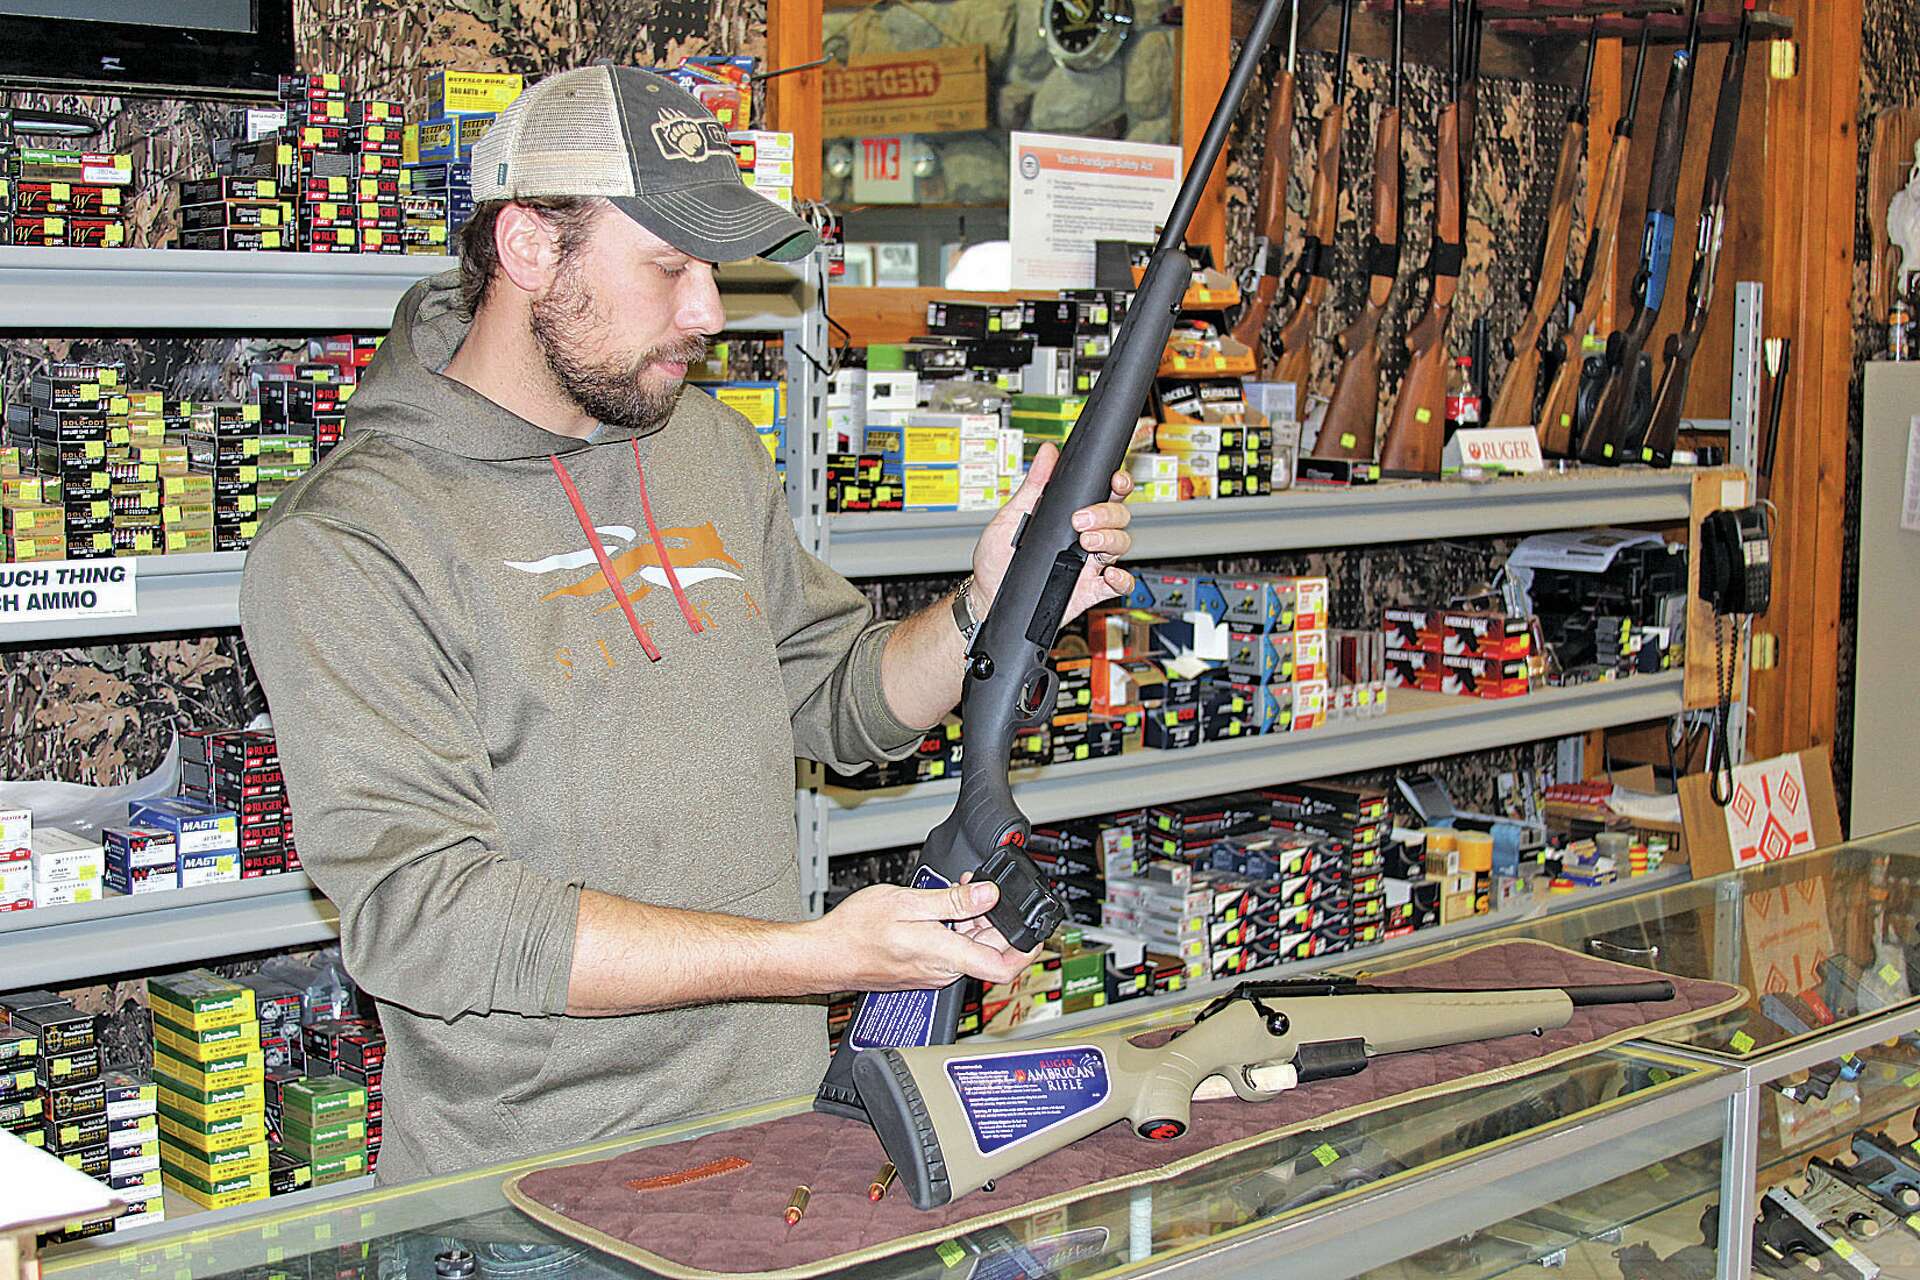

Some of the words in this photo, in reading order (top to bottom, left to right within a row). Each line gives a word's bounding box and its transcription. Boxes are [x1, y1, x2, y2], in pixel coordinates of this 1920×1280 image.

[1056, 153, 1078, 165] Youth
[1080, 156, 1115, 170] Handgun
[1116, 160, 1140, 171] Safety
[1140, 162, 1153, 171] Act
[1482, 440, 1533, 460] RUGER
[56, 565, 126, 585] THING
[0, 594, 19, 612] H
[26, 590, 98, 610] AMMO
[920, 740, 940, 752] CCI
[252, 772, 282, 784] RUGER
[252, 800, 282, 812] RUGER
[182, 819, 219, 832] MAGTE
[252, 826, 282, 838] RUGER
[184, 856, 217, 868] MAGT
[253, 854, 282, 868] RUGER
[1040, 1058, 1074, 1068] RUGER
[1028, 1066, 1096, 1082] AMERICAN
[1047, 1079, 1084, 1091] RIFLE
